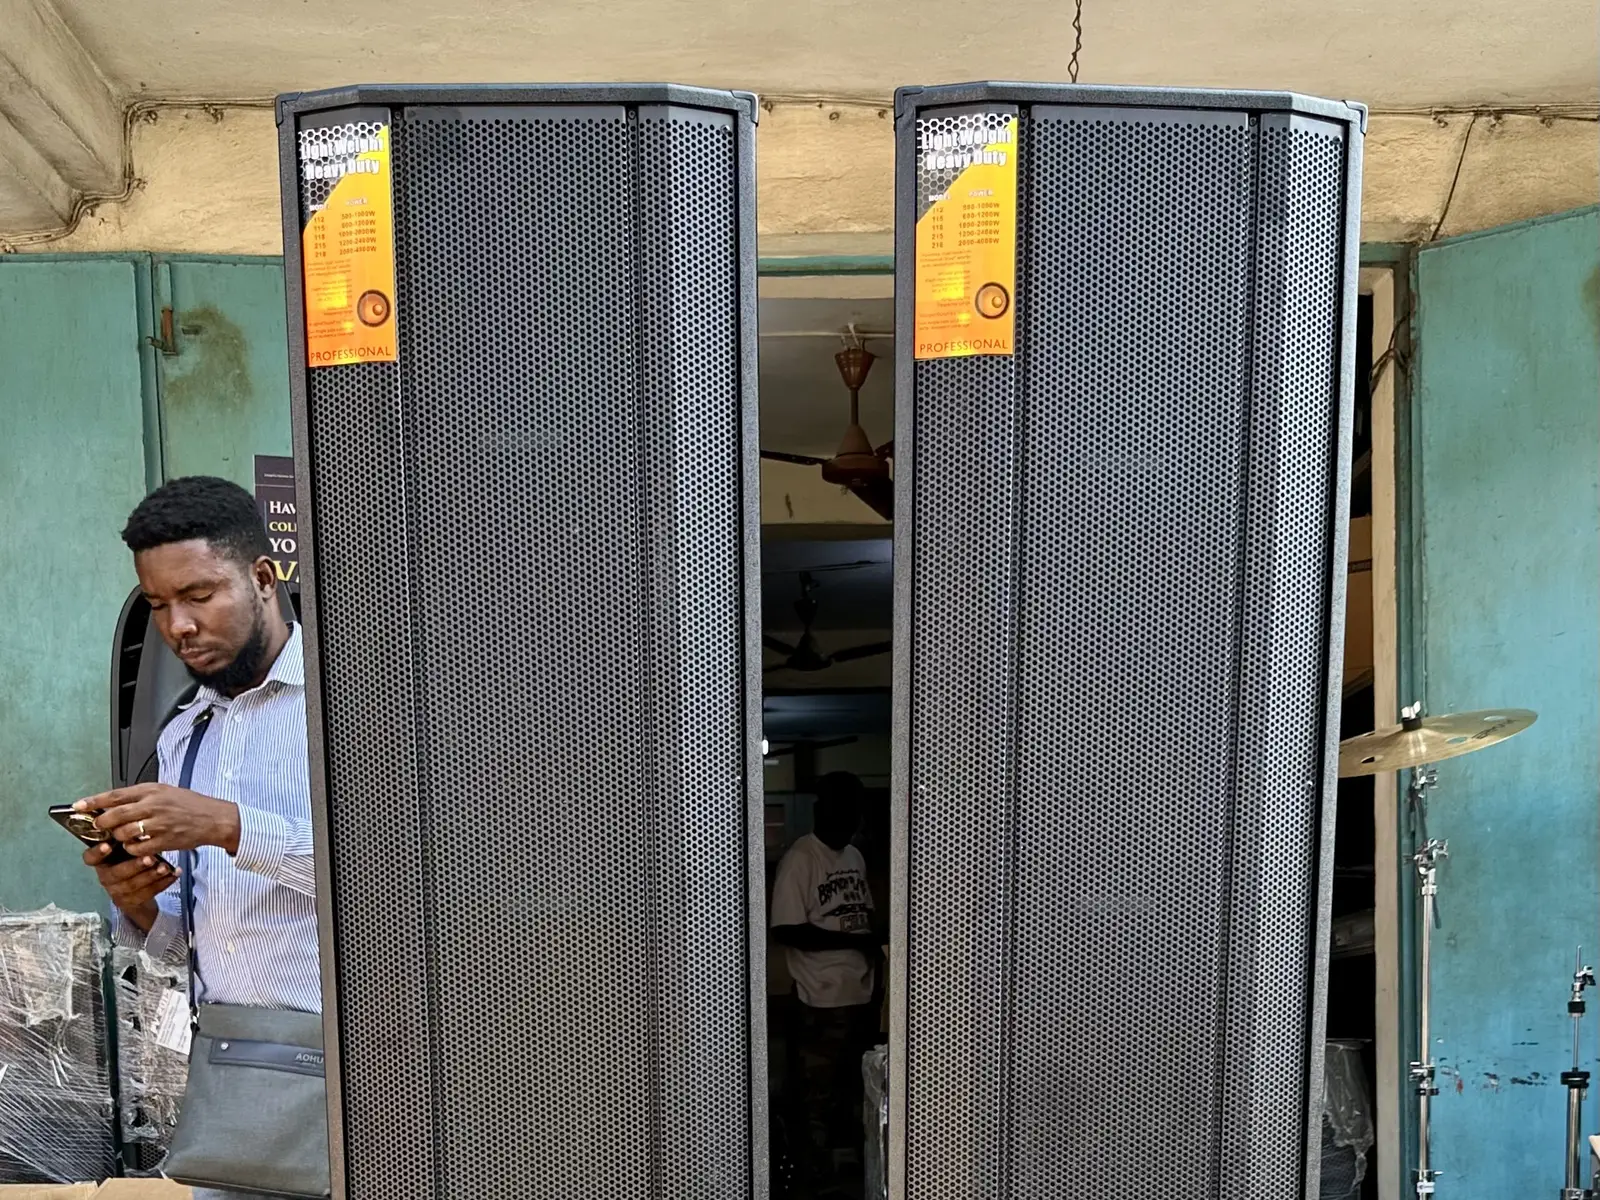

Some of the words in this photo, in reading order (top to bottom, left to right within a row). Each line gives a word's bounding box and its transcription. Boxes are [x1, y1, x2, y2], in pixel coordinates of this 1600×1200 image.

[311, 346, 391, 362] PROFESSIONAL
[919, 339, 1008, 354] PROFESSIONAL
[273, 560, 300, 584] V
